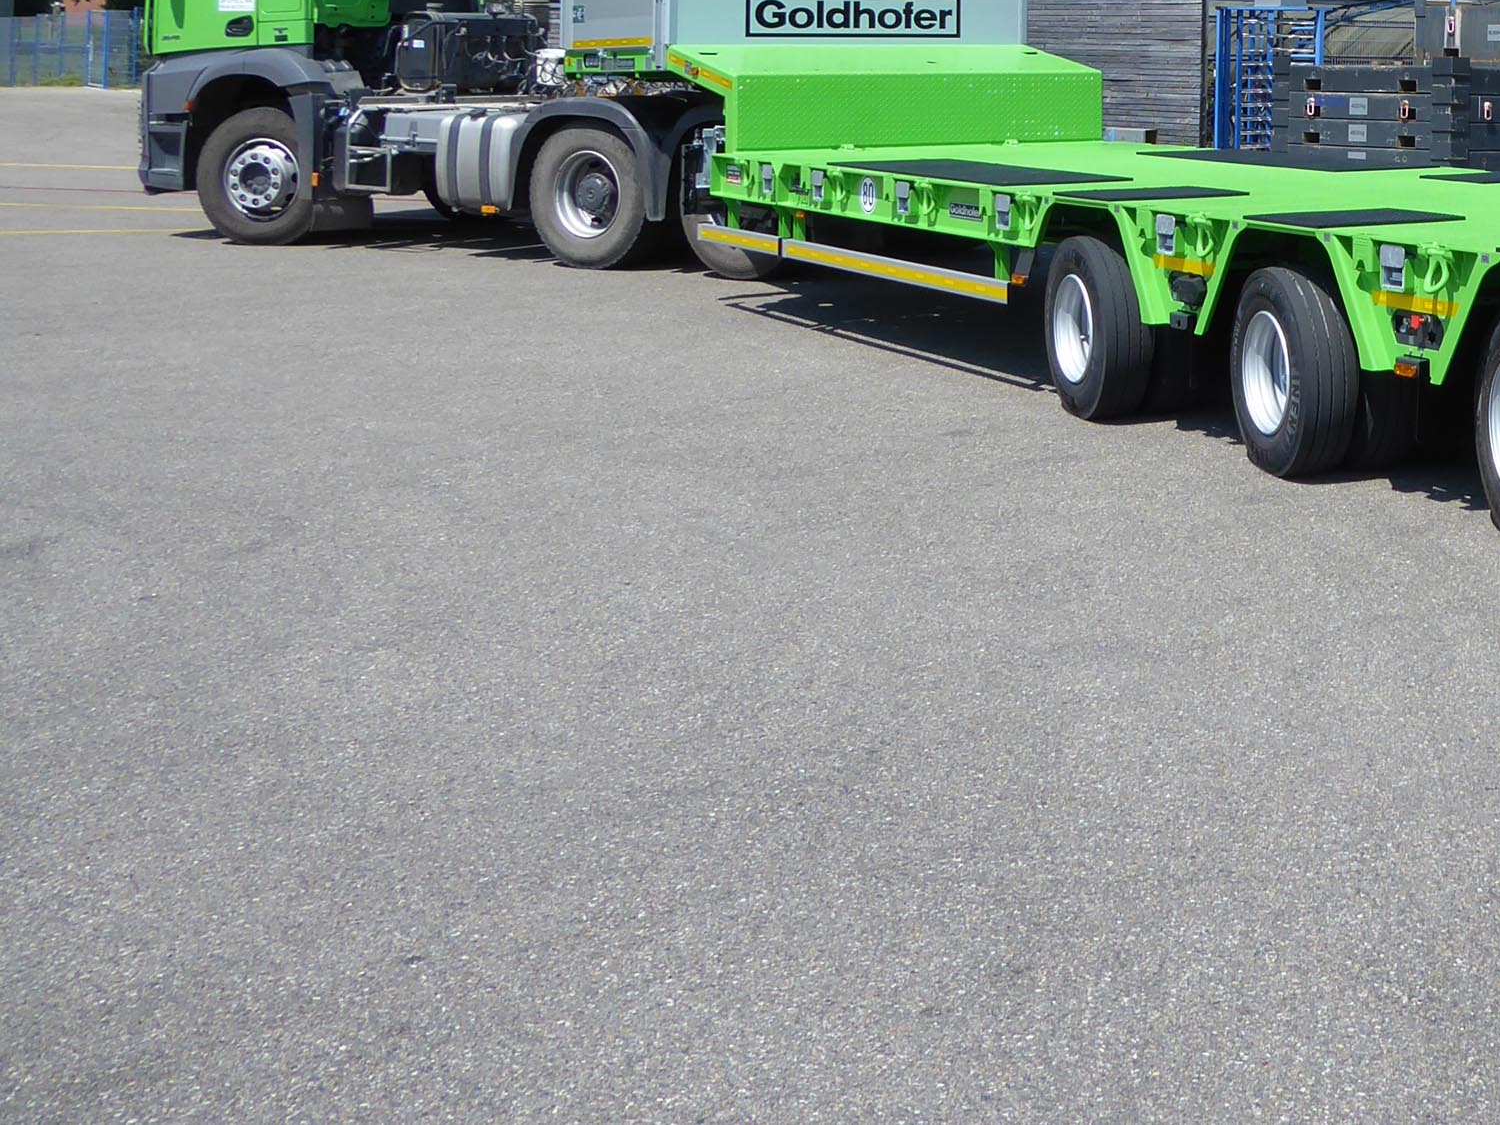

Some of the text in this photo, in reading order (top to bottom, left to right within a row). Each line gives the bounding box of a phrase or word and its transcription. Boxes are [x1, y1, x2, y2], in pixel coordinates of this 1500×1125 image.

[755, 0, 953, 29] Goldhofer
[863, 181, 874, 206] 80
[950, 203, 980, 218] Goldhofe
